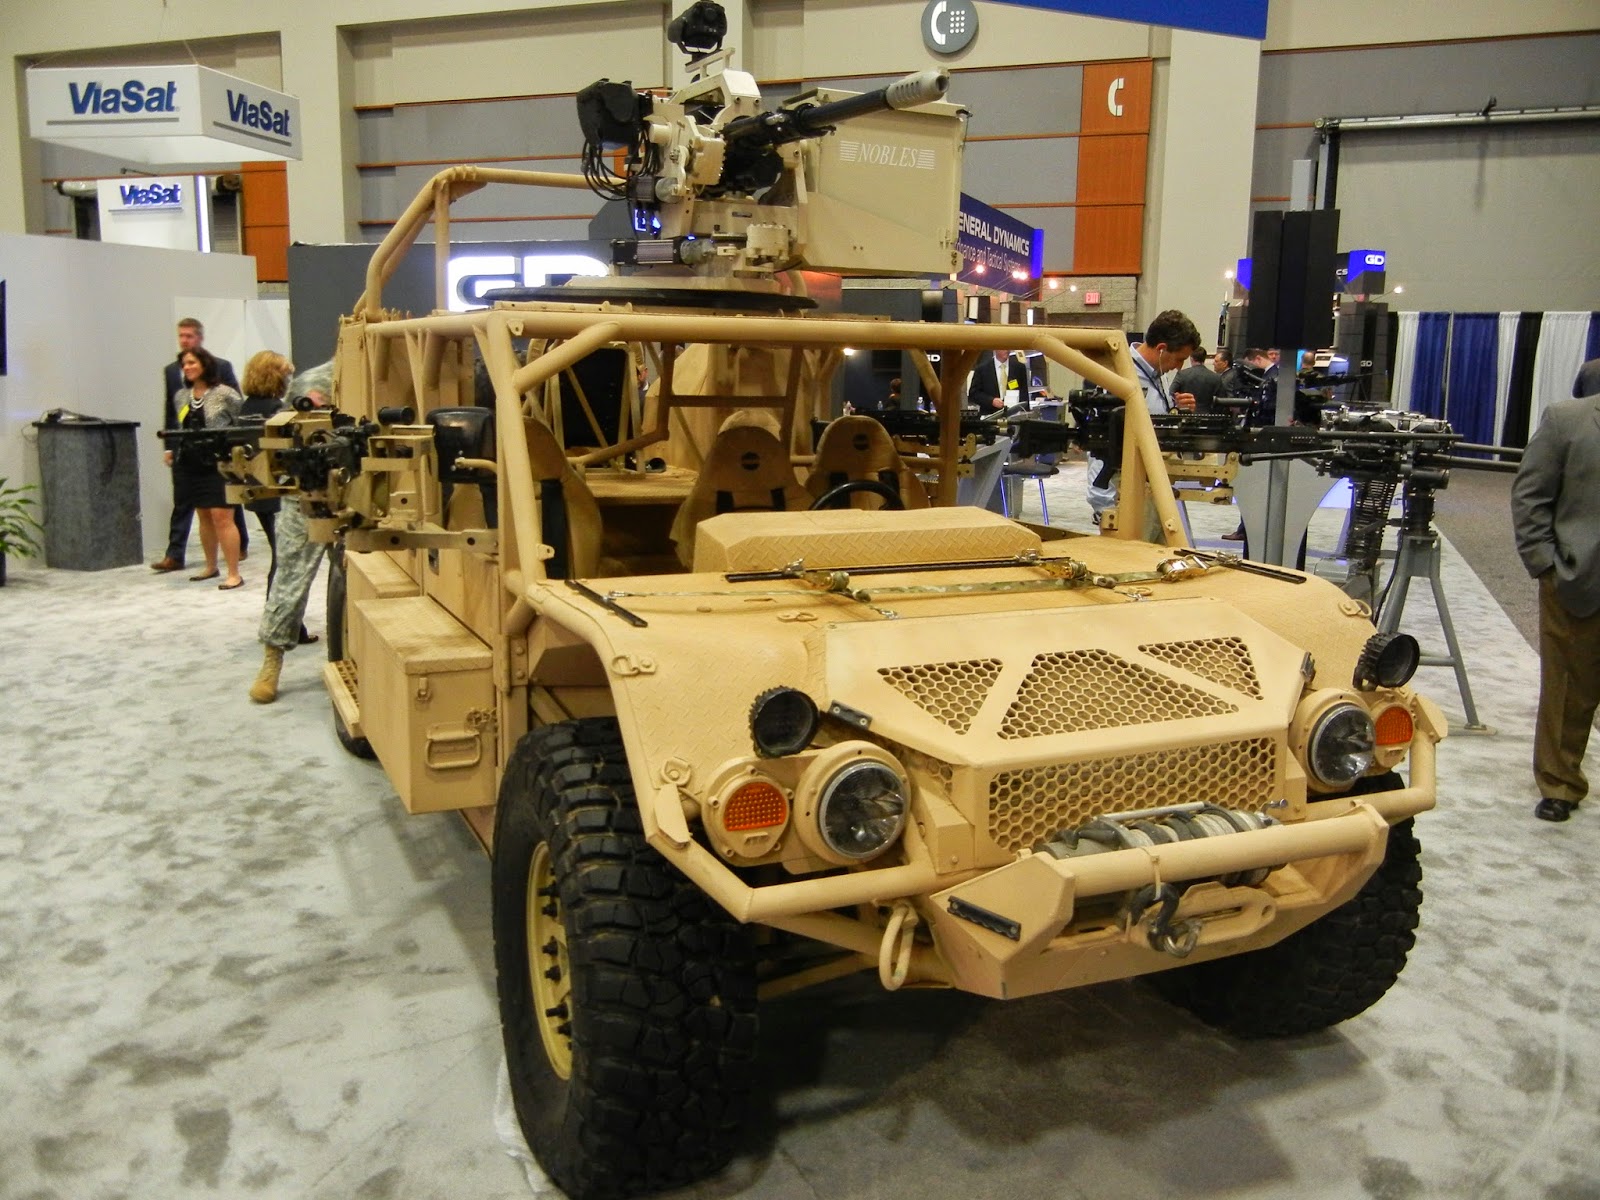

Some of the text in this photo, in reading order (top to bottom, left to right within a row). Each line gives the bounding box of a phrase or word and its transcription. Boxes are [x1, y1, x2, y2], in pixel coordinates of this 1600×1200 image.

[69, 80, 178, 115] ViaSat
[227, 89, 290, 137] ViaSat
[858, 143, 918, 168] NOBLES
[119, 183, 182, 207] ViaSat
[959, 211, 1029, 256] ENERAL DYNAMICS
[1365, 254, 1384, 265] GD
[1086, 292, 1099, 304] EXIT
